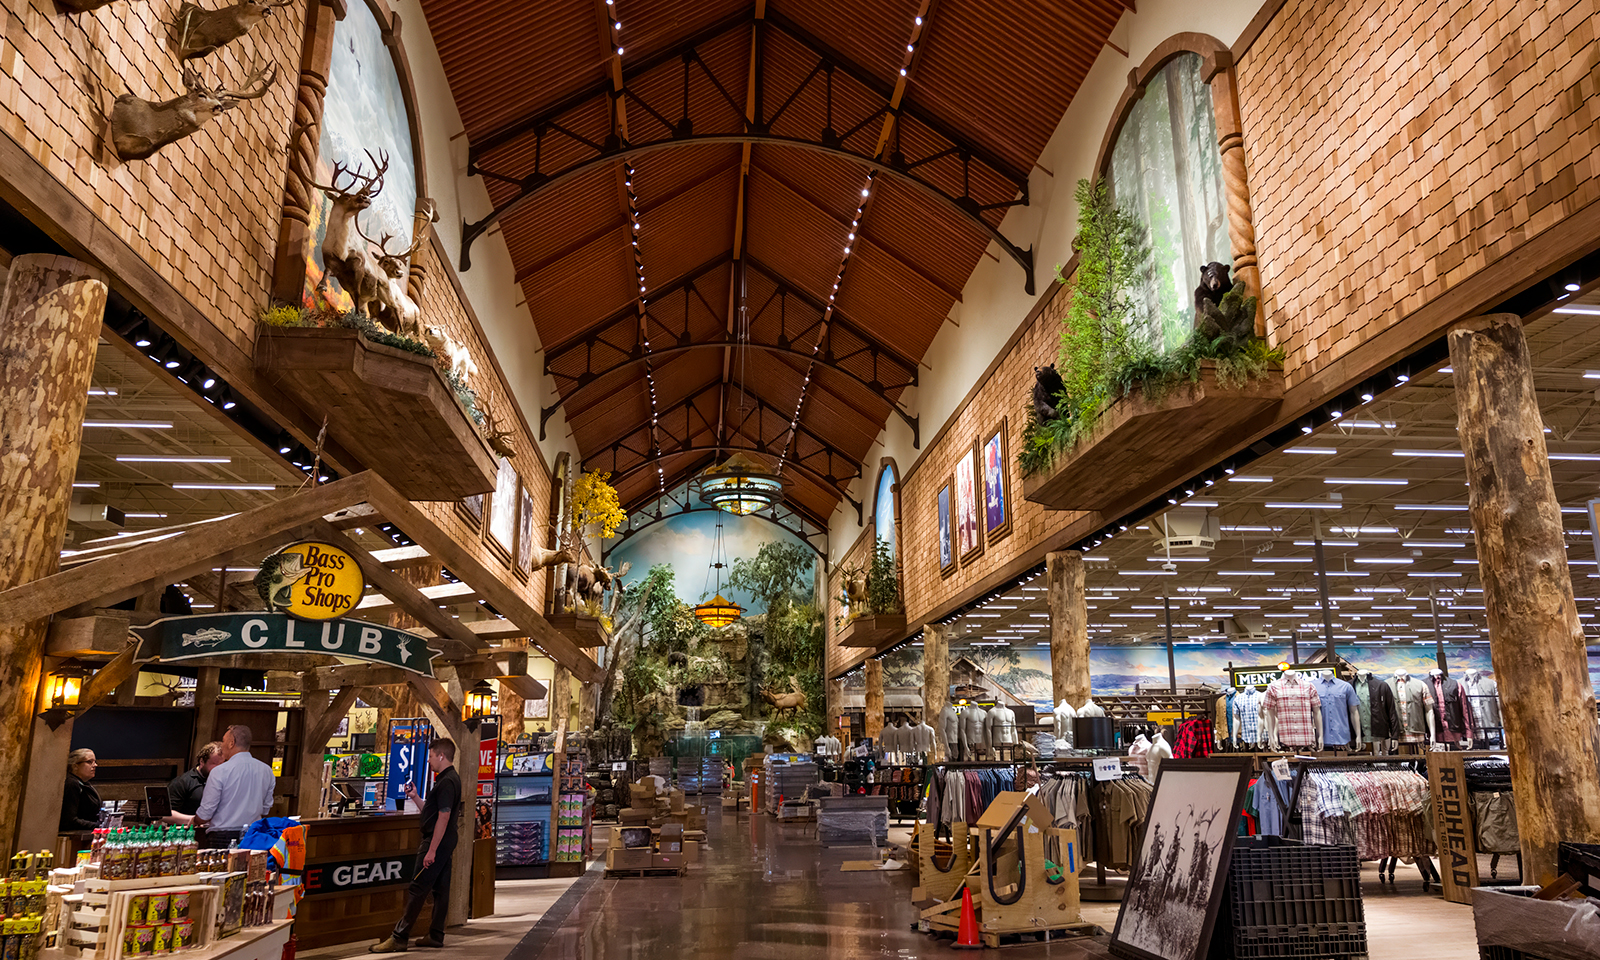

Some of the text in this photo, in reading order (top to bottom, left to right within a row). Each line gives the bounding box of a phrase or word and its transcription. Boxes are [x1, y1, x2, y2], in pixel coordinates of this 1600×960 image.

[304, 546, 345, 570] Bass
[304, 567, 335, 588] Pro
[302, 587, 351, 612] Shops
[241, 618, 383, 655] CLUB
[1238, 673, 1276, 685] MEN'S
[480, 750, 493, 766] VE
[1436, 794, 1446, 827] SINCE
[1439, 768, 1471, 887] REDHEAD
[305, 861, 403, 889] E GEAR
